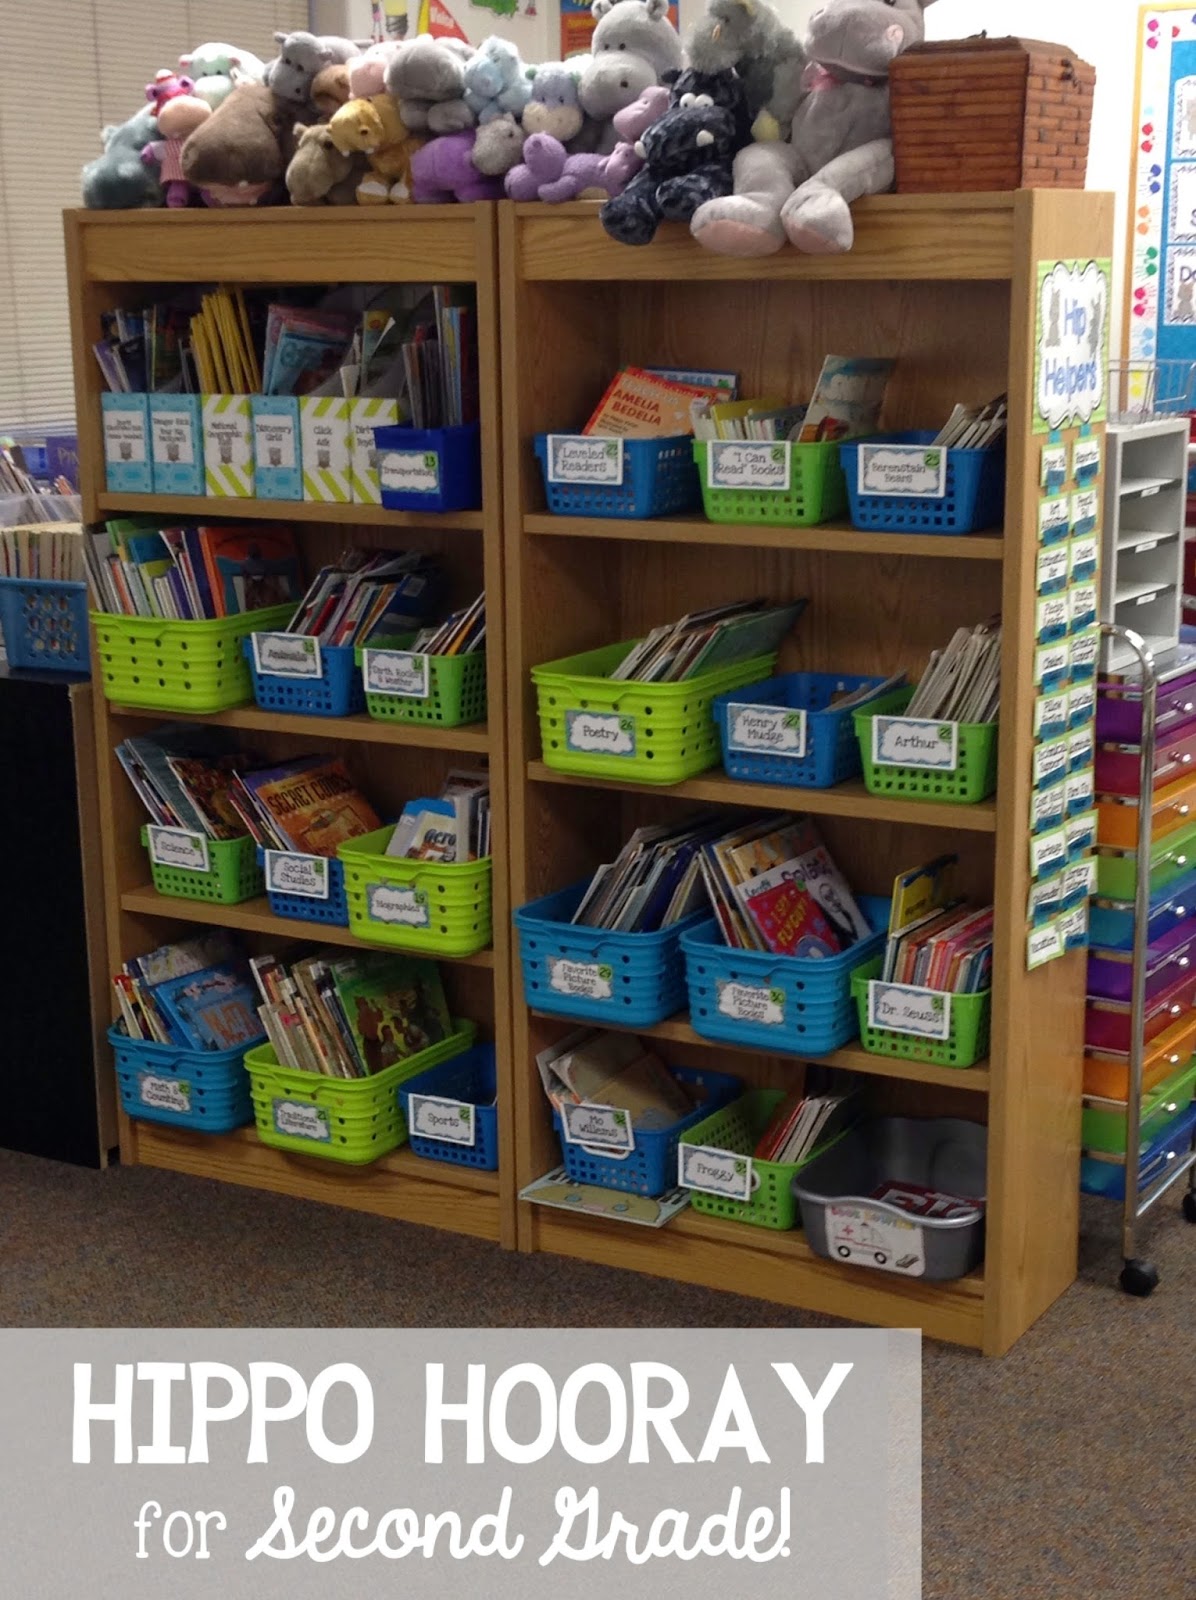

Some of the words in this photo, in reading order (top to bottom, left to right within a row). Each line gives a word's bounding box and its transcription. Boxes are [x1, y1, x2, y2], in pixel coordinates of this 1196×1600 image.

[1044, 355, 1098, 403] Helpers
[612, 388, 661, 413] AMELIA
[611, 399, 663, 427] BEDELIA
[255, 423, 292, 435] Discovery
[562, 446, 605, 460] Leveled
[744, 452, 766, 464] Can
[924, 453, 941, 467] 25
[424, 455, 436, 468] 13
[561, 459, 608, 473] Readers
[871, 462, 926, 474] Berenstain
[383, 466, 434, 478] Transportation
[750, 464, 786, 476] Books
[883, 473, 913, 483] Bears
[620, 719, 633, 731] 26
[742, 714, 777, 731] Henry
[583, 724, 619, 742] Poetry
[747, 729, 784, 745] Mudge
[894, 734, 939, 750] Arthur
[266, 783, 316, 817] SECRET
[160, 840, 195, 857] Science
[283, 861, 312, 876] Social
[280, 871, 317, 887] Studies
[414, 892, 425, 905] 19
[375, 899, 420, 913] Biographies
[561, 963, 598, 977] Favorite
[599, 966, 612, 979] 29
[563, 972, 597, 986] Picture
[567, 982, 594, 994] Books
[732, 986, 770, 1001] Favorite
[732, 996, 768, 1011] Picture
[737, 1007, 765, 1020] Books
[881, 1001, 899, 1016] Dr.
[902, 1006, 940, 1023] Seuss
[150, 1082, 171, 1093] Math
[145, 1090, 186, 1109] Counting
[317, 1110, 327, 1121] 21
[427, 1112, 460, 1127] Sports
[588, 1115, 605, 1126] Mo
[579, 1124, 618, 1137] Willems
[697, 1163, 735, 1182] Froggy
